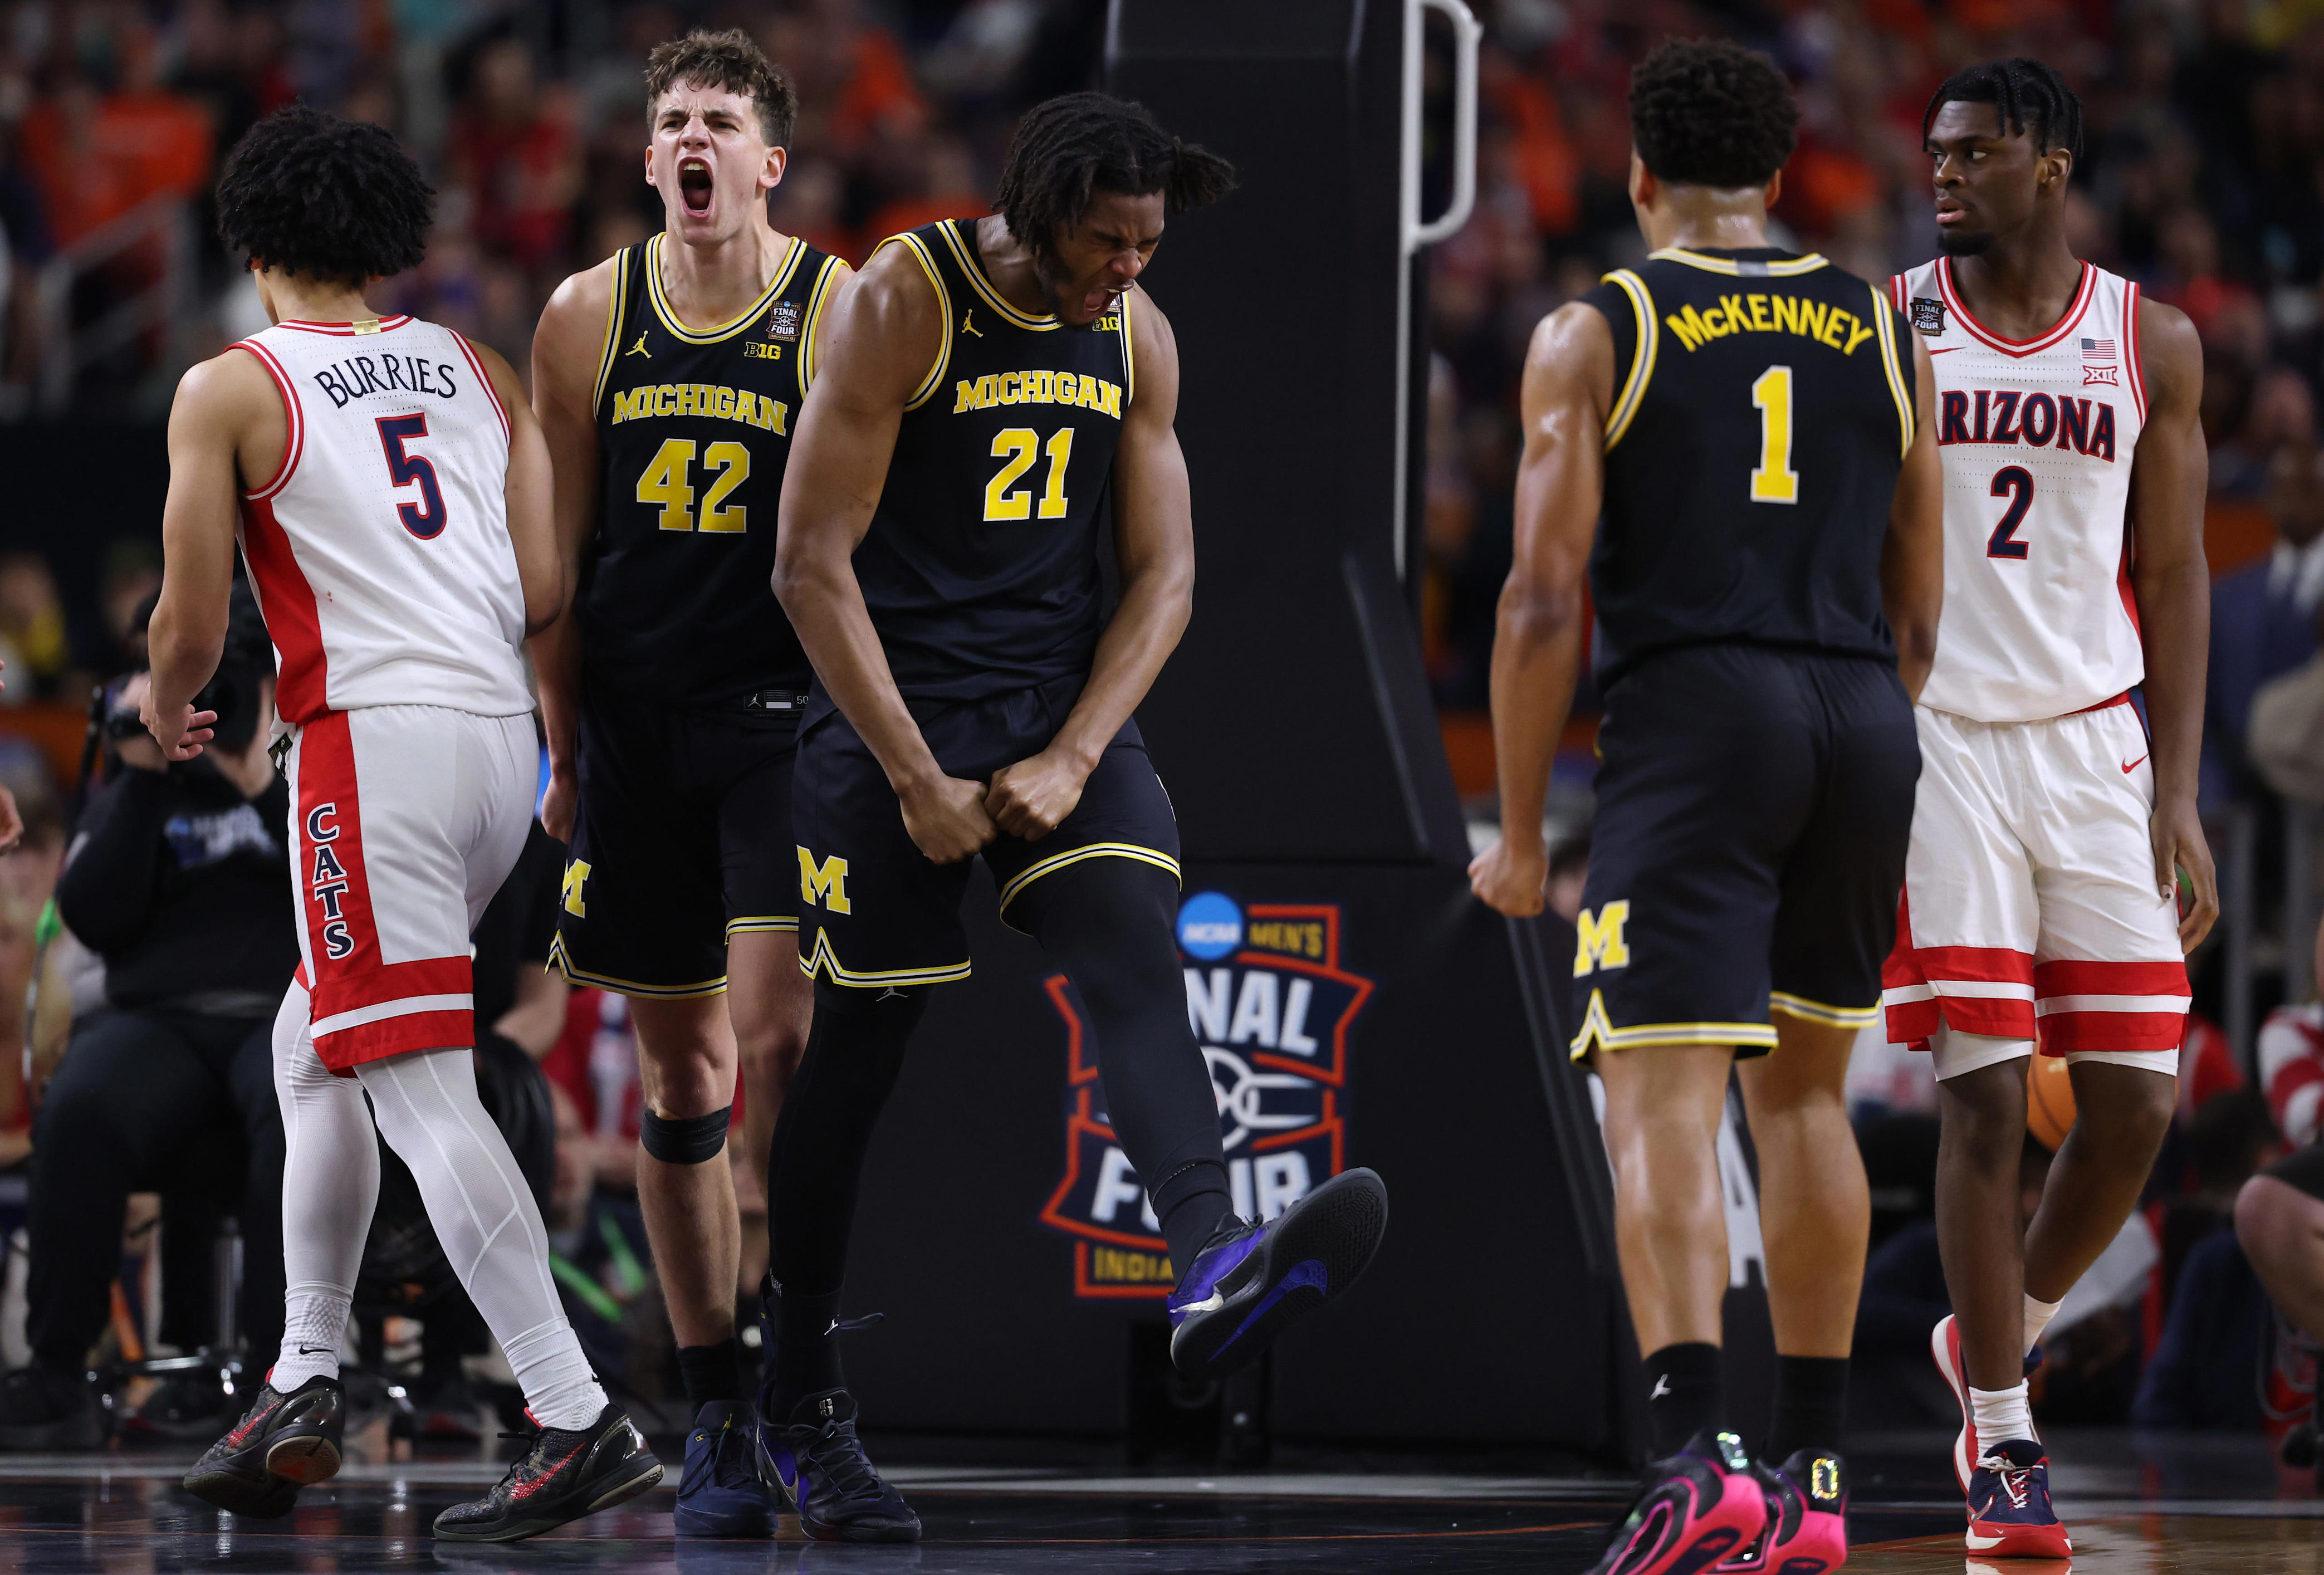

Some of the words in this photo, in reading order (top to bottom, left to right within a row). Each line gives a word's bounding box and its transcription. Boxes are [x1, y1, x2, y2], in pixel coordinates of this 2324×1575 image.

[771, 324, 795, 335] FOUR
[774, 307, 797, 318] FINAL
[1665, 294, 1875, 356] McKENNEY
[1915, 305, 1940, 314] FINAL
[1915, 320, 1939, 329] FOUR
[314, 354, 457, 409] BURRIES
[612, 383, 788, 437] MICHIGAN
[953, 370, 1122, 420] MICHIGAN
[1750, 365, 1799, 505] 1
[1935, 390, 2115, 463] RIZONA
[375, 412, 447, 540] 5
[636, 438, 750, 533] 42
[983, 427, 1075, 522] 21
[1987, 466, 2034, 560] 2
[307, 802, 355, 960] CATS
[796, 844, 852, 915] M
[1573, 899, 1630, 979] M
[1183, 967, 1319, 1057] NAL
